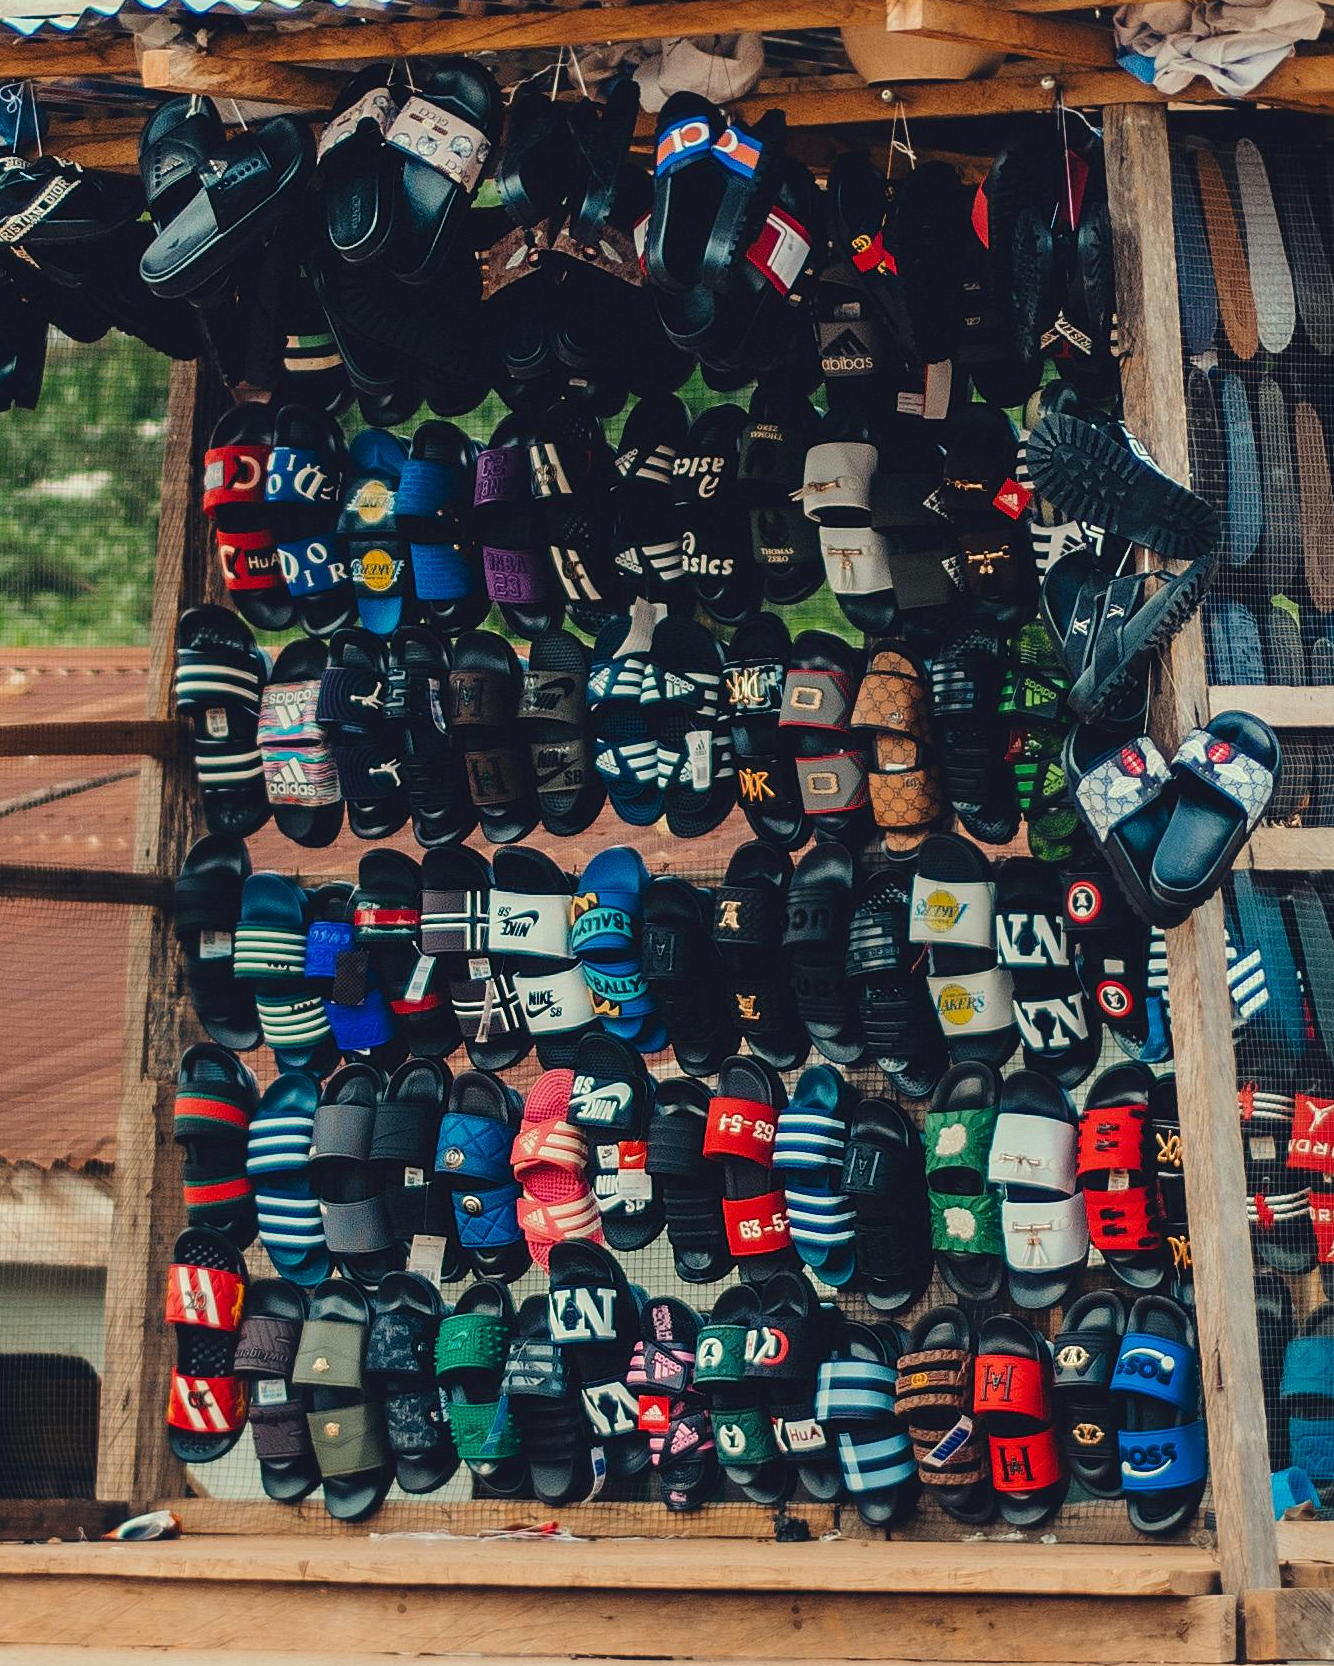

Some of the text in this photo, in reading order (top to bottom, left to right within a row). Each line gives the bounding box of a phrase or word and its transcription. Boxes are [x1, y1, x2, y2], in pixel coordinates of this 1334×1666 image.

[268, 689, 313, 705] adidas
[1024, 678, 1057, 701] adidas
[268, 782, 317, 796] adidas
[499, 921, 532, 937] NIKE
[528, 989, 555, 1005] NIKE
[577, 1099, 618, 1121] NIKE
